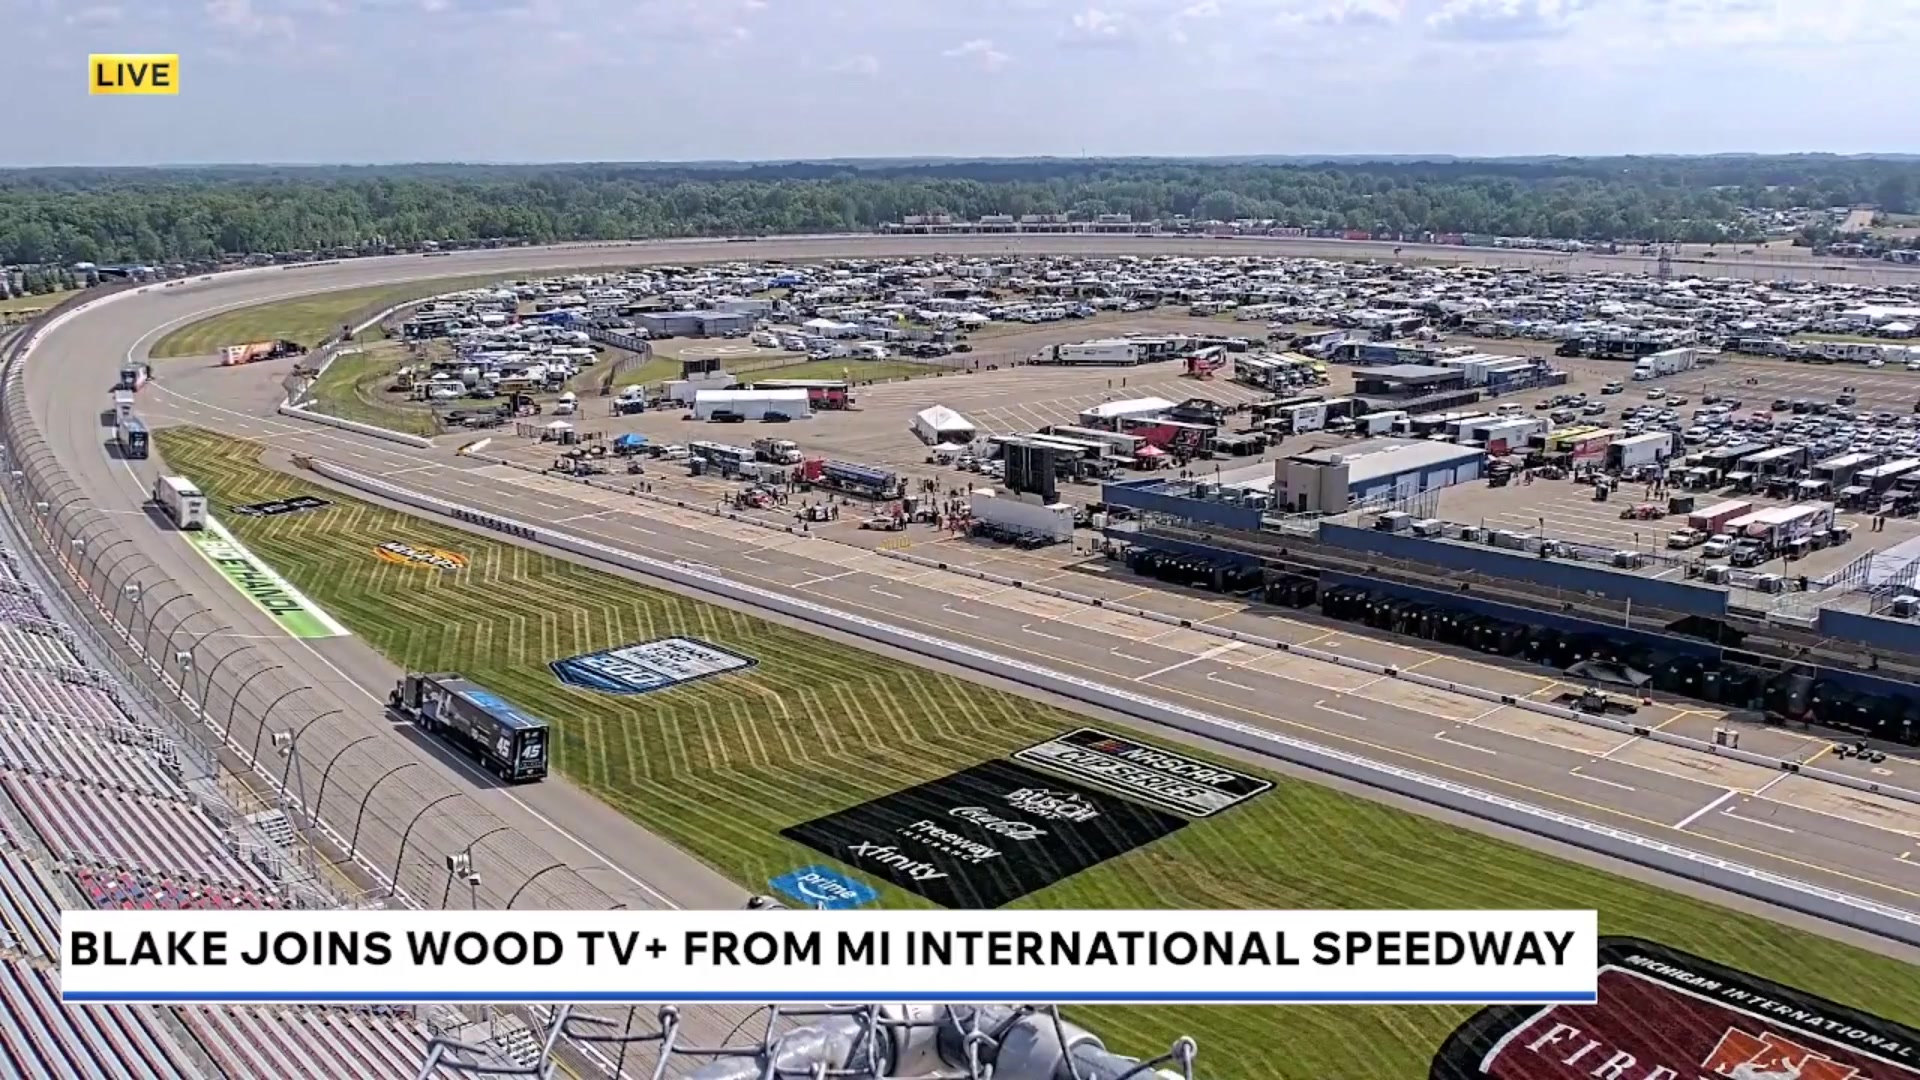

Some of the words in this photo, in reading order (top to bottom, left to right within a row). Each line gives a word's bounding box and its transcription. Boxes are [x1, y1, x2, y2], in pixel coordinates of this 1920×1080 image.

[582, 656, 662, 684] 200
[496, 736, 511, 759] 45
[521, 744, 542, 759] 45
[1055, 751, 1118, 768] CUP
[1104, 766, 1208, 798] SERIES
[1118, 748, 1236, 785] NASCAR
[1002, 787, 1100, 823] BUSCH
[896, 828, 983, 864] INSURANCE
[909, 819, 1002, 860] Freeway
[848, 840, 949, 881] xfinity
[797, 873, 857, 899] prime
[1625, 954, 1722, 991] MICHIGAN
[1722, 985, 1912, 1057] INTERNATIONAL
